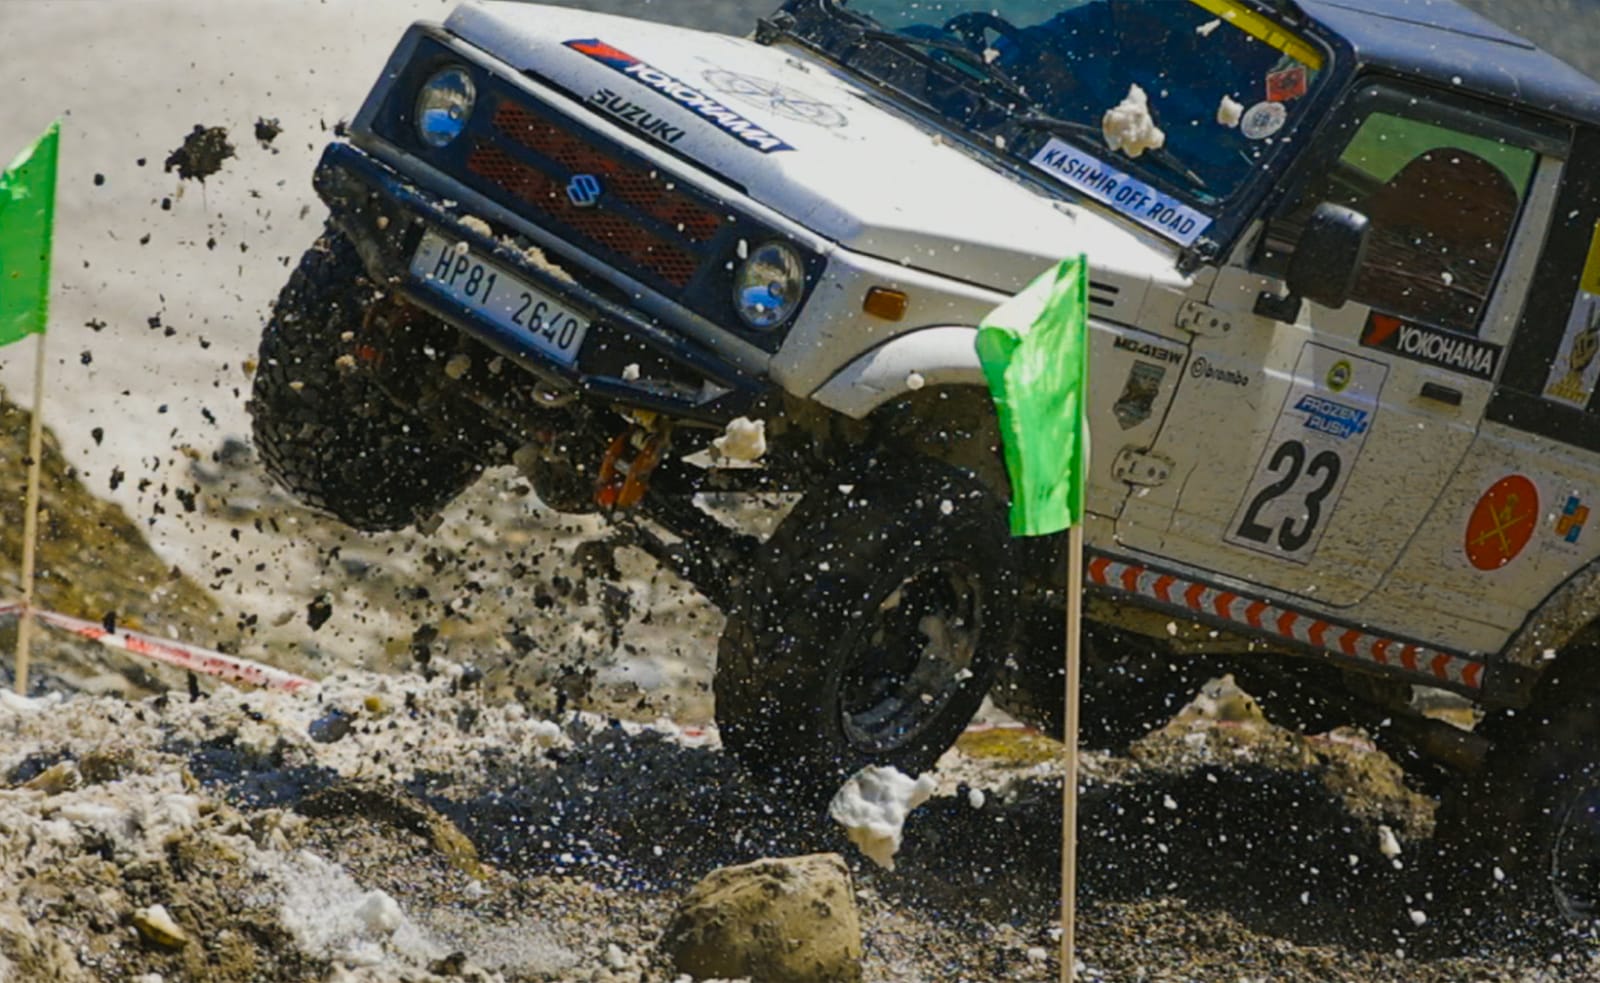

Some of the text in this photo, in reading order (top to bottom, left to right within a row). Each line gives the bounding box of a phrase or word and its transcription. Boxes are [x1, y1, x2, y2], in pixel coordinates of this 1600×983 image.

[589, 87, 686, 143] SUZUKI
[624, 63, 782, 149] YOKOHAMA
[1042, 148, 1197, 236] KASHMIR OFF ROAD
[433, 245, 578, 350] HP81 2640
[1396, 324, 1494, 375] YOKOHAMA
[1301, 396, 1358, 422] FROZEN
[1309, 414, 1352, 438] RUSH
[1236, 440, 1342, 552] 23
